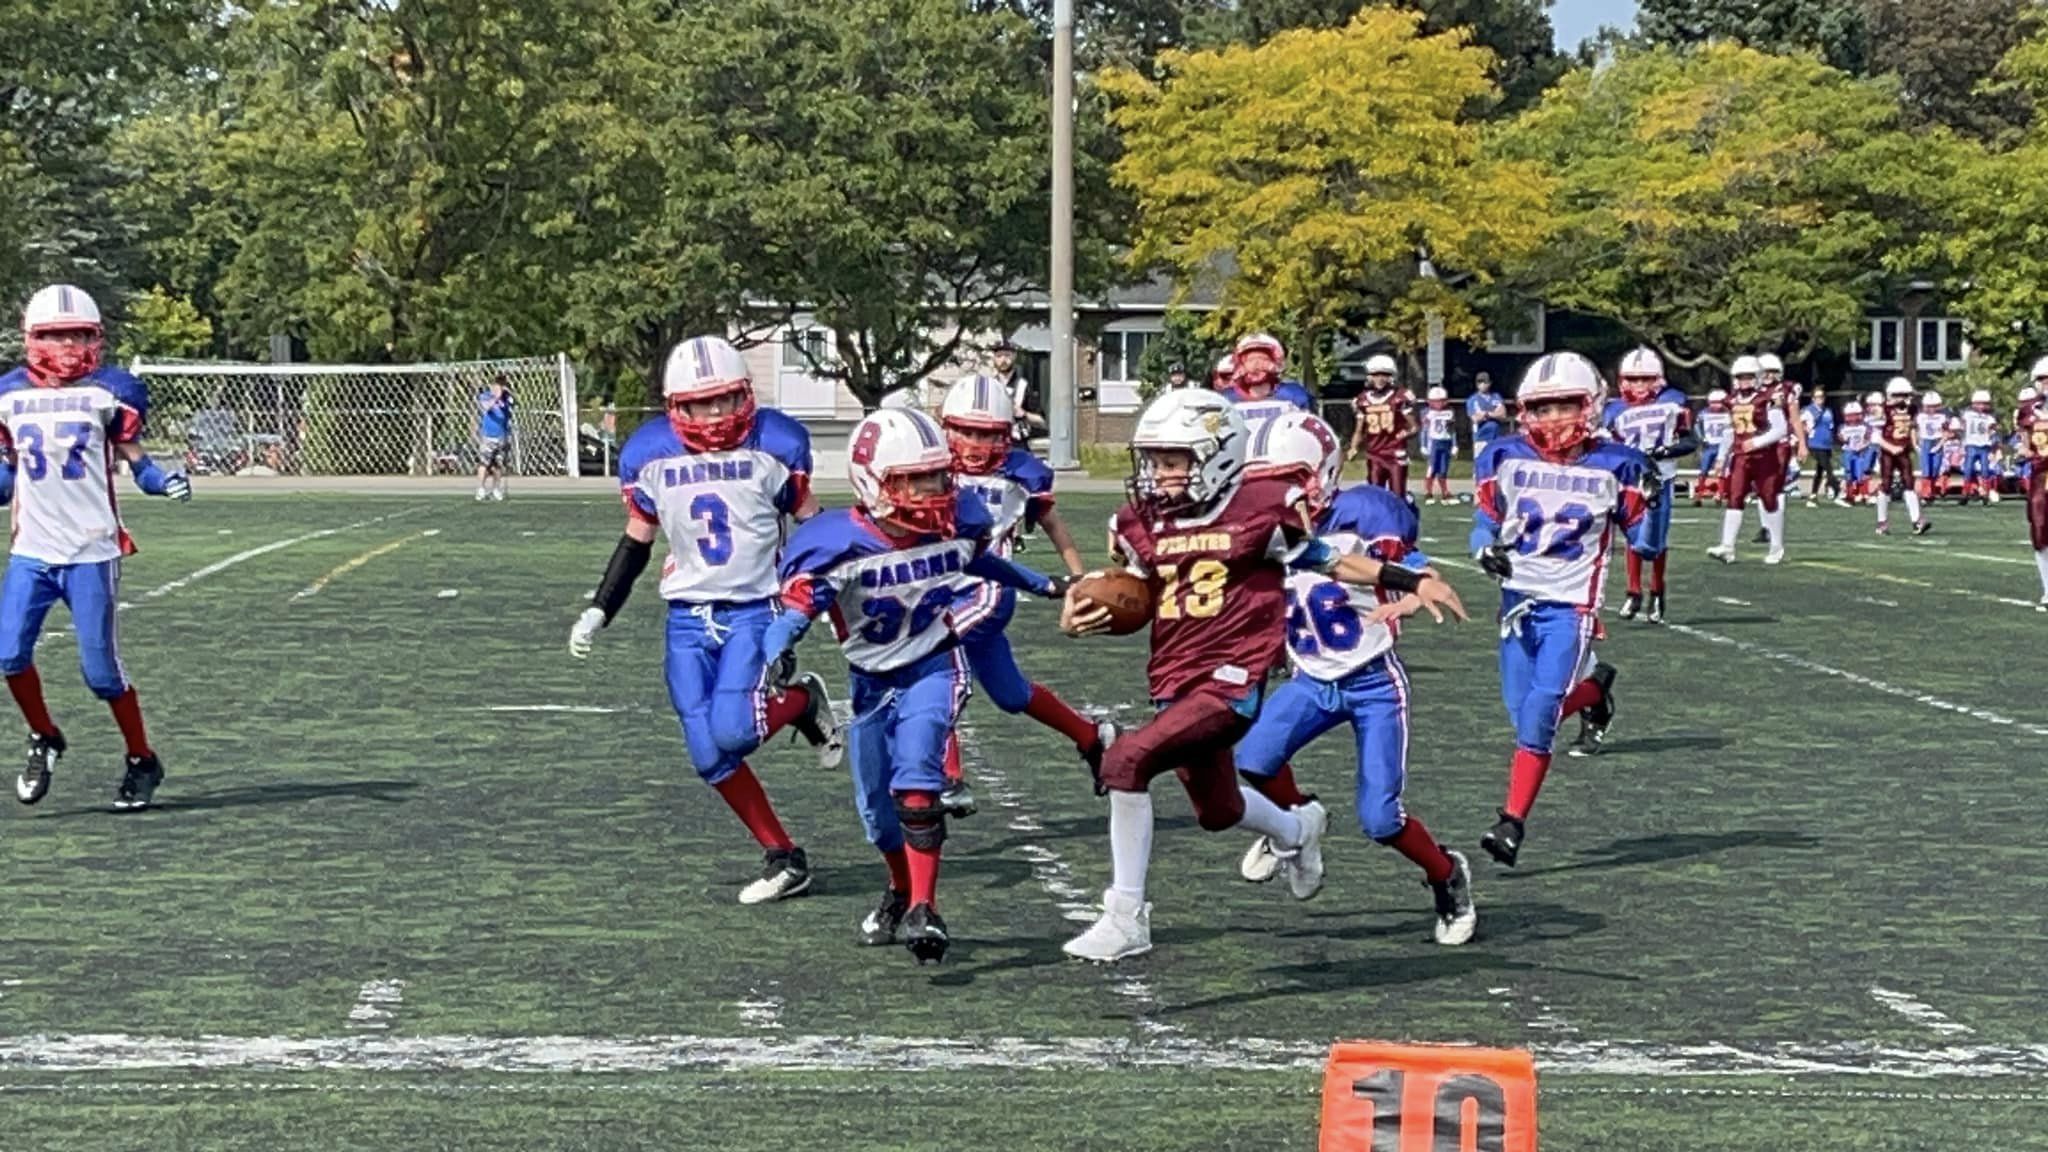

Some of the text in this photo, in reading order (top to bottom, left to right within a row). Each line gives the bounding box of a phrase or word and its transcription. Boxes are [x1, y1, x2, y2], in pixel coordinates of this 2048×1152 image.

[17, 421, 93, 481] 37
[690, 492, 735, 567] 3
[1156, 532, 1232, 556] PIRATES
[1352, 1068, 1507, 1152] 10
